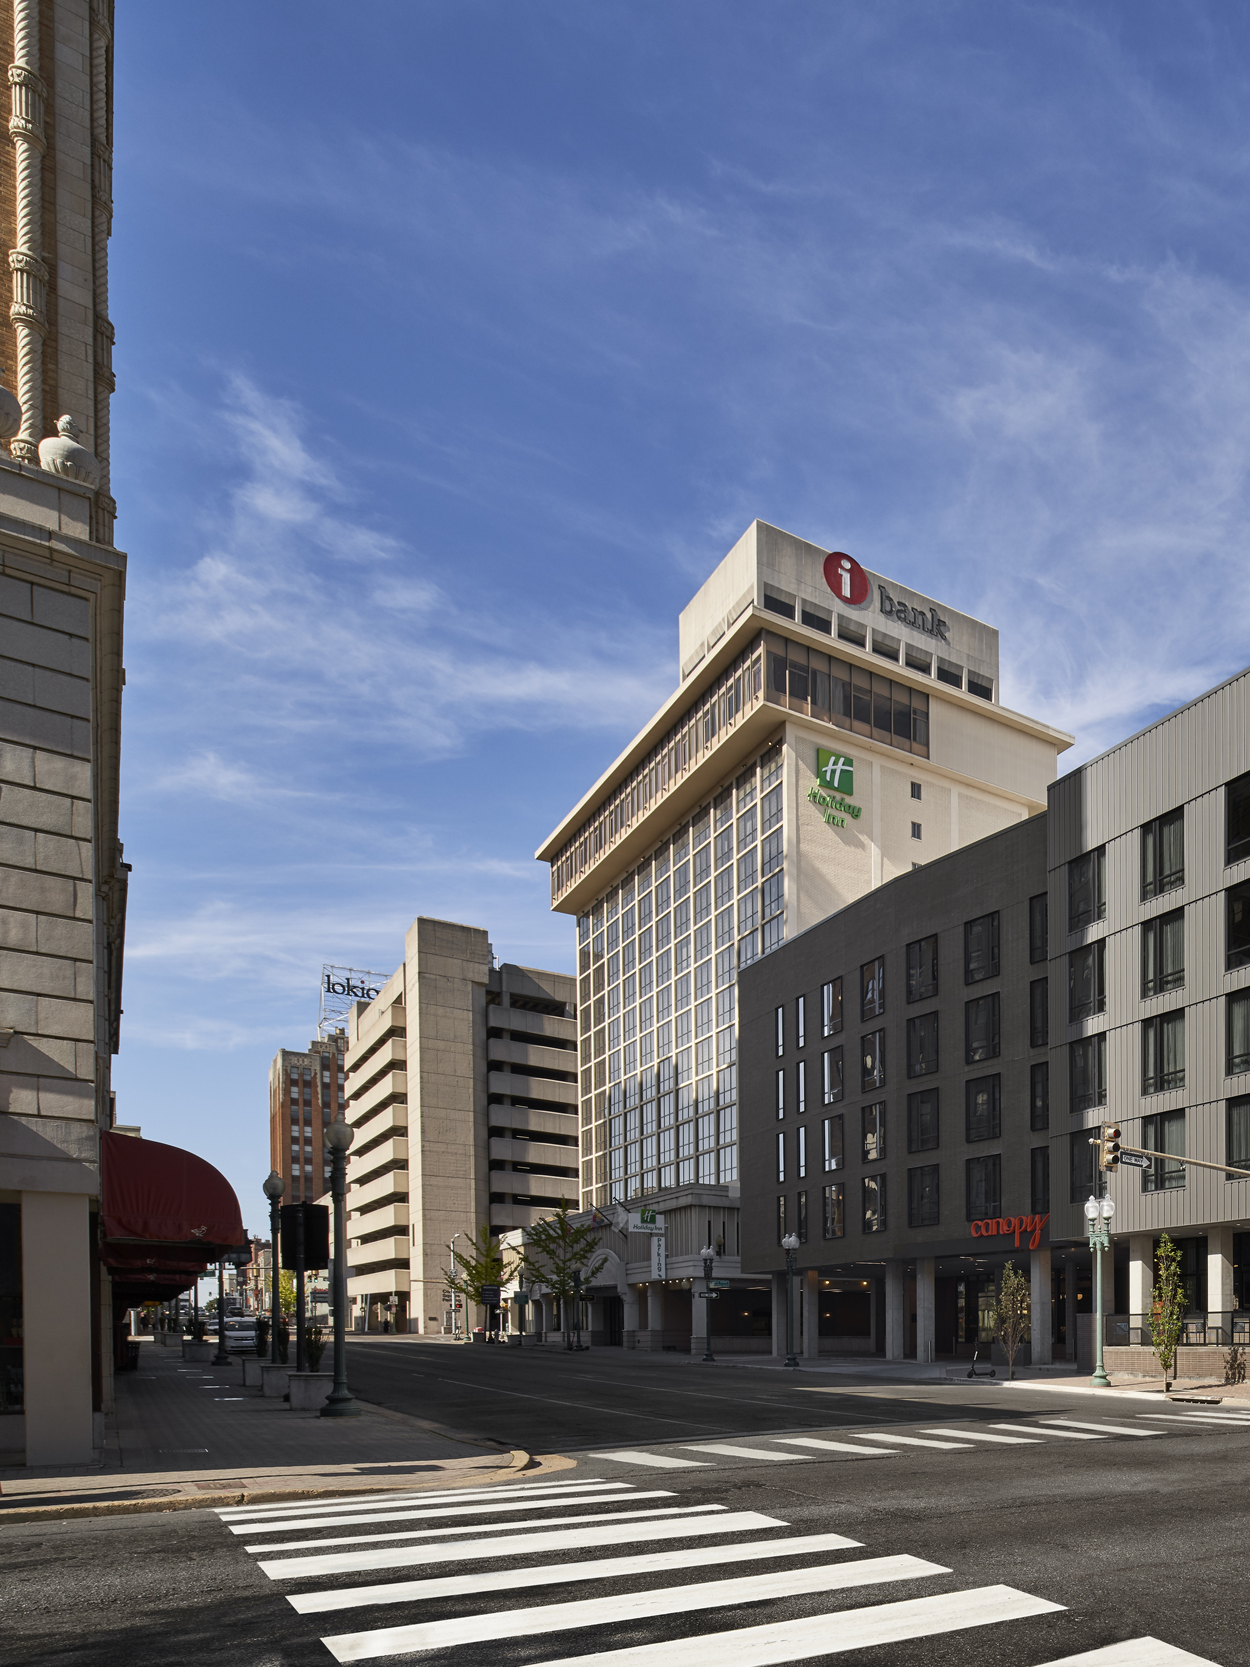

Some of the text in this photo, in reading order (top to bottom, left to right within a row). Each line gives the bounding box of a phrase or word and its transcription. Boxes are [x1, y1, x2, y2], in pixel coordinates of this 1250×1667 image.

[878, 584, 947, 640] bank
[807, 786, 862, 820] Holiday
[823, 808, 847, 828] Inn
[970, 1212, 1050, 1250] canopy
